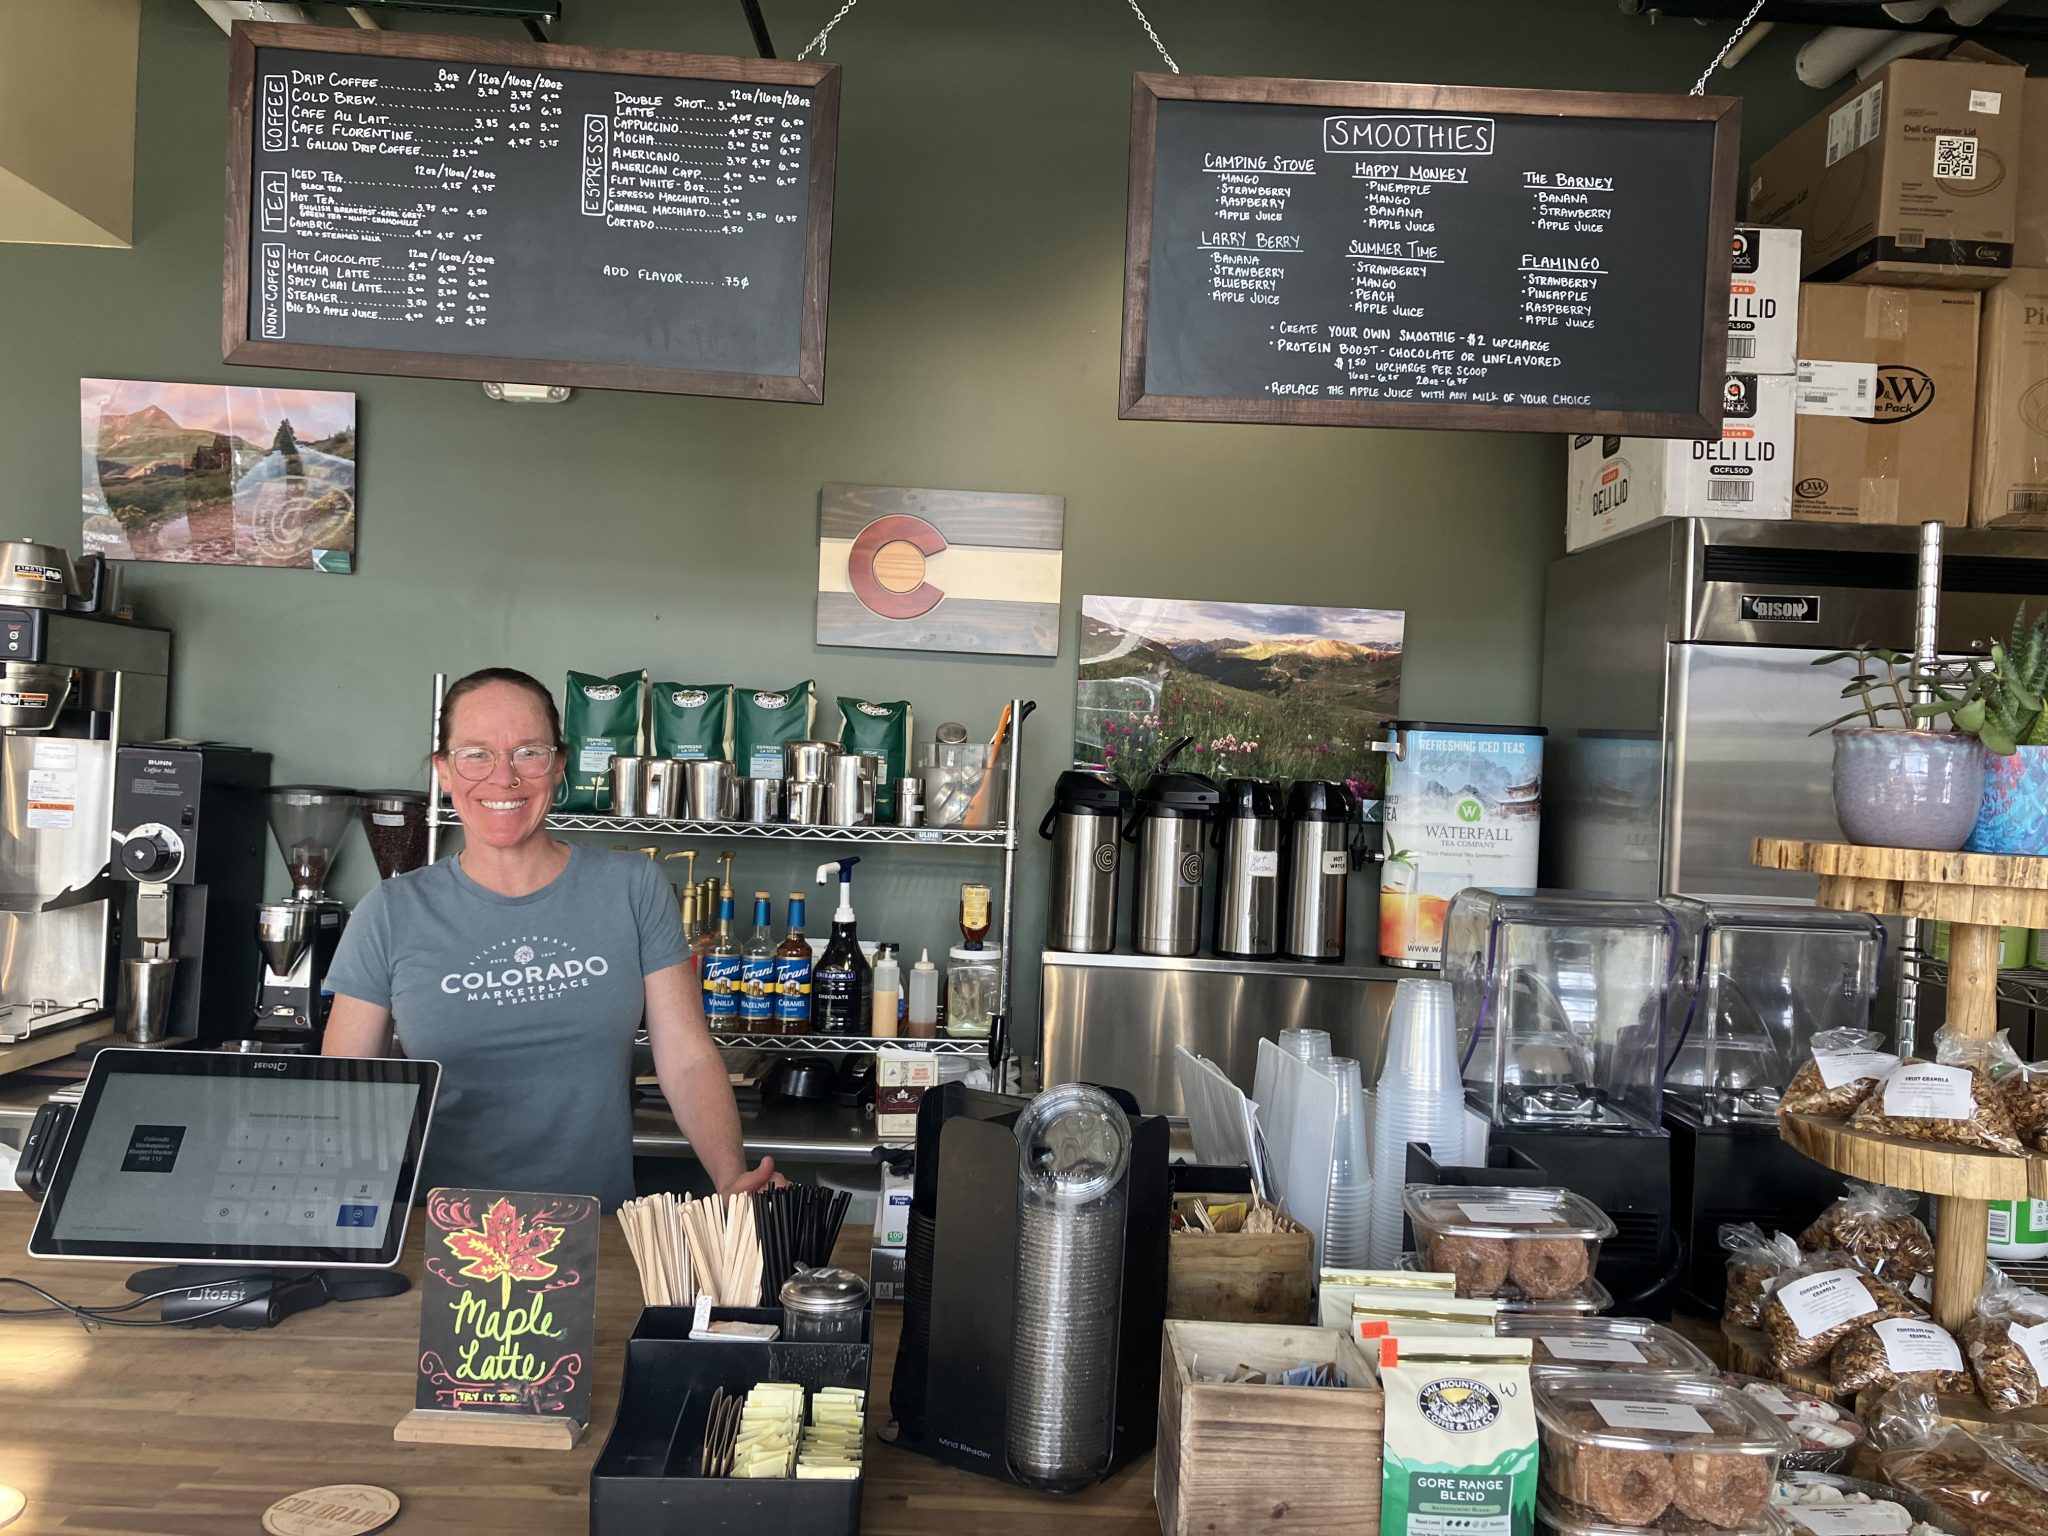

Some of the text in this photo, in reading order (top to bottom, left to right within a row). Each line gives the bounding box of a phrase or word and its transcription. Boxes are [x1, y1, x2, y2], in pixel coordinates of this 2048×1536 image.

[291, 70, 379, 88] DRIP COFFEE
[291, 88, 376, 105] COLD BREW
[614, 91, 706, 109] DOUBLE SHOT
[266, 80, 284, 148] COFFEE
[291, 105, 389, 125] CAFE AU LAIT
[616, 105, 656, 117] LATTE
[291, 120, 413, 141] CAFE FLORENTINE
[613, 116, 679, 133] CAPPUCCINO
[613, 131, 655, 146] MOCHA
[1331, 120, 1488, 151] SMOOTHIES
[291, 136, 421, 155] 1 GALLON DRIP COFFEE
[613, 146, 680, 162] AMERICANO
[1204, 152, 1315, 172] CAMPING STOVE
[585, 119, 604, 210] ESPRESSO
[611, 161, 701, 179] AMERICAN CAPP
[1355, 162, 1467, 183] HAPPY MONKEY
[291, 168, 344, 183] ICED TEA
[610, 175, 675, 189] FLAT WHITE
[1221, 173, 1260, 184] MANGO
[1522, 171, 1613, 189] THE BARNEY
[608, 187, 710, 205] ESPRESSO MACCHIATO
[1221, 184, 1291, 198] STRAWBERRY
[1369, 182, 1431, 195] PINEAPPLE
[265, 180, 284, 226] TEA
[290, 192, 335, 205] HOT TEA
[1220, 196, 1285, 210] RASPBERRY
[1369, 194, 1411, 206] MANGO
[1538, 192, 1588, 204] BANANA
[607, 199, 706, 217] CARAMEL MACCHIATO
[1219, 210, 1283, 222] APPLE JUICE
[1369, 206, 1423, 219] BANANA
[1539, 204, 1612, 220] STRAWBERRY
[606, 214, 655, 229] CORTADO
[1537, 218, 1604, 233] APPLE JUICE
[1202, 231, 1300, 249] LARRY BERRY
[1349, 240, 1438, 258] SUMMER TIME
[287, 248, 382, 267] HOT CHOCOLATE
[1214, 252, 1260, 265] BANANA
[1521, 254, 1600, 270] FLAMINGO
[287, 262, 370, 279] MATCHA LATTE
[603, 264, 683, 283] ADD FLAVOR
[1214, 264, 1284, 279] STRAWBERRY
[1357, 262, 1427, 277] STRAWBERRY
[287, 274, 383, 293] SPICY CHAI LATTE
[1213, 277, 1276, 291] BLUEBERRY
[1357, 277, 1397, 289] MANGO
[1528, 273, 1597, 289] STRAWBERRY
[287, 287, 339, 304] STEAMER
[1356, 289, 1395, 302] PEACH
[1528, 287, 1588, 301] PINEAPPLE
[286, 301, 379, 320] BIG APPLE JUICE
[1526, 302, 1592, 316] RASPBERRY
[1746, 298, 1777, 319] LID
[1279, 321, 1550, 352] CREATE YOUR OWN SMOOTHIE UPCHARGE
[1277, 339, 1562, 367] PROTEIN BOOST CHOCOLATE OR UNFLAVORED
[1375, 361, 1488, 378] UPCHARGE PER SCOOP
[1271, 383, 1591, 406] REPLACE THE APPLE JUICE WITH ANY MILK OF YOUR CHOICE
[1885, 402, 1913, 413] Pack
[1692, 440, 1775, 461] DELI LID
[1757, 602, 1802, 617] BISON
[1419, 739, 1525, 754] REFRESHING ICED TEAS
[148, 759, 173, 767] BUNN
[39, 803, 70, 811] WARNING
[919, 831, 939, 839] ULINE
[1425, 825, 1513, 841] WATERFALL
[1457, 840, 1495, 849] COMPANY
[441, 956, 608, 994] COLORADO
[706, 961, 741, 981] Torani
[742, 962, 774, 983] Torani
[776, 963, 810, 983] Torani
[467, 978, 590, 1001] MARKETPLACE
[512, 991, 562, 1004] BAKERY
[778, 999, 806, 1007] CARAMEL
[253, 1061, 280, 1071] toast
[204, 1287, 246, 1301] toast
[449, 1290, 563, 1355] Maple
[456, 1339, 546, 1381] Latte
[457, 1392, 495, 1402] TRY IT
[1423, 1380, 1489, 1398] VAIL MOUNTAIN
[1425, 1409, 1495, 1431] COFFEE & TEA CO
[939, 1437, 991, 1459] Mind Reader
[1417, 1477, 1504, 1490] GORE RANGE
[1440, 1490, 1485, 1502] BLEND
[272, 1497, 390, 1527] COLORADO
